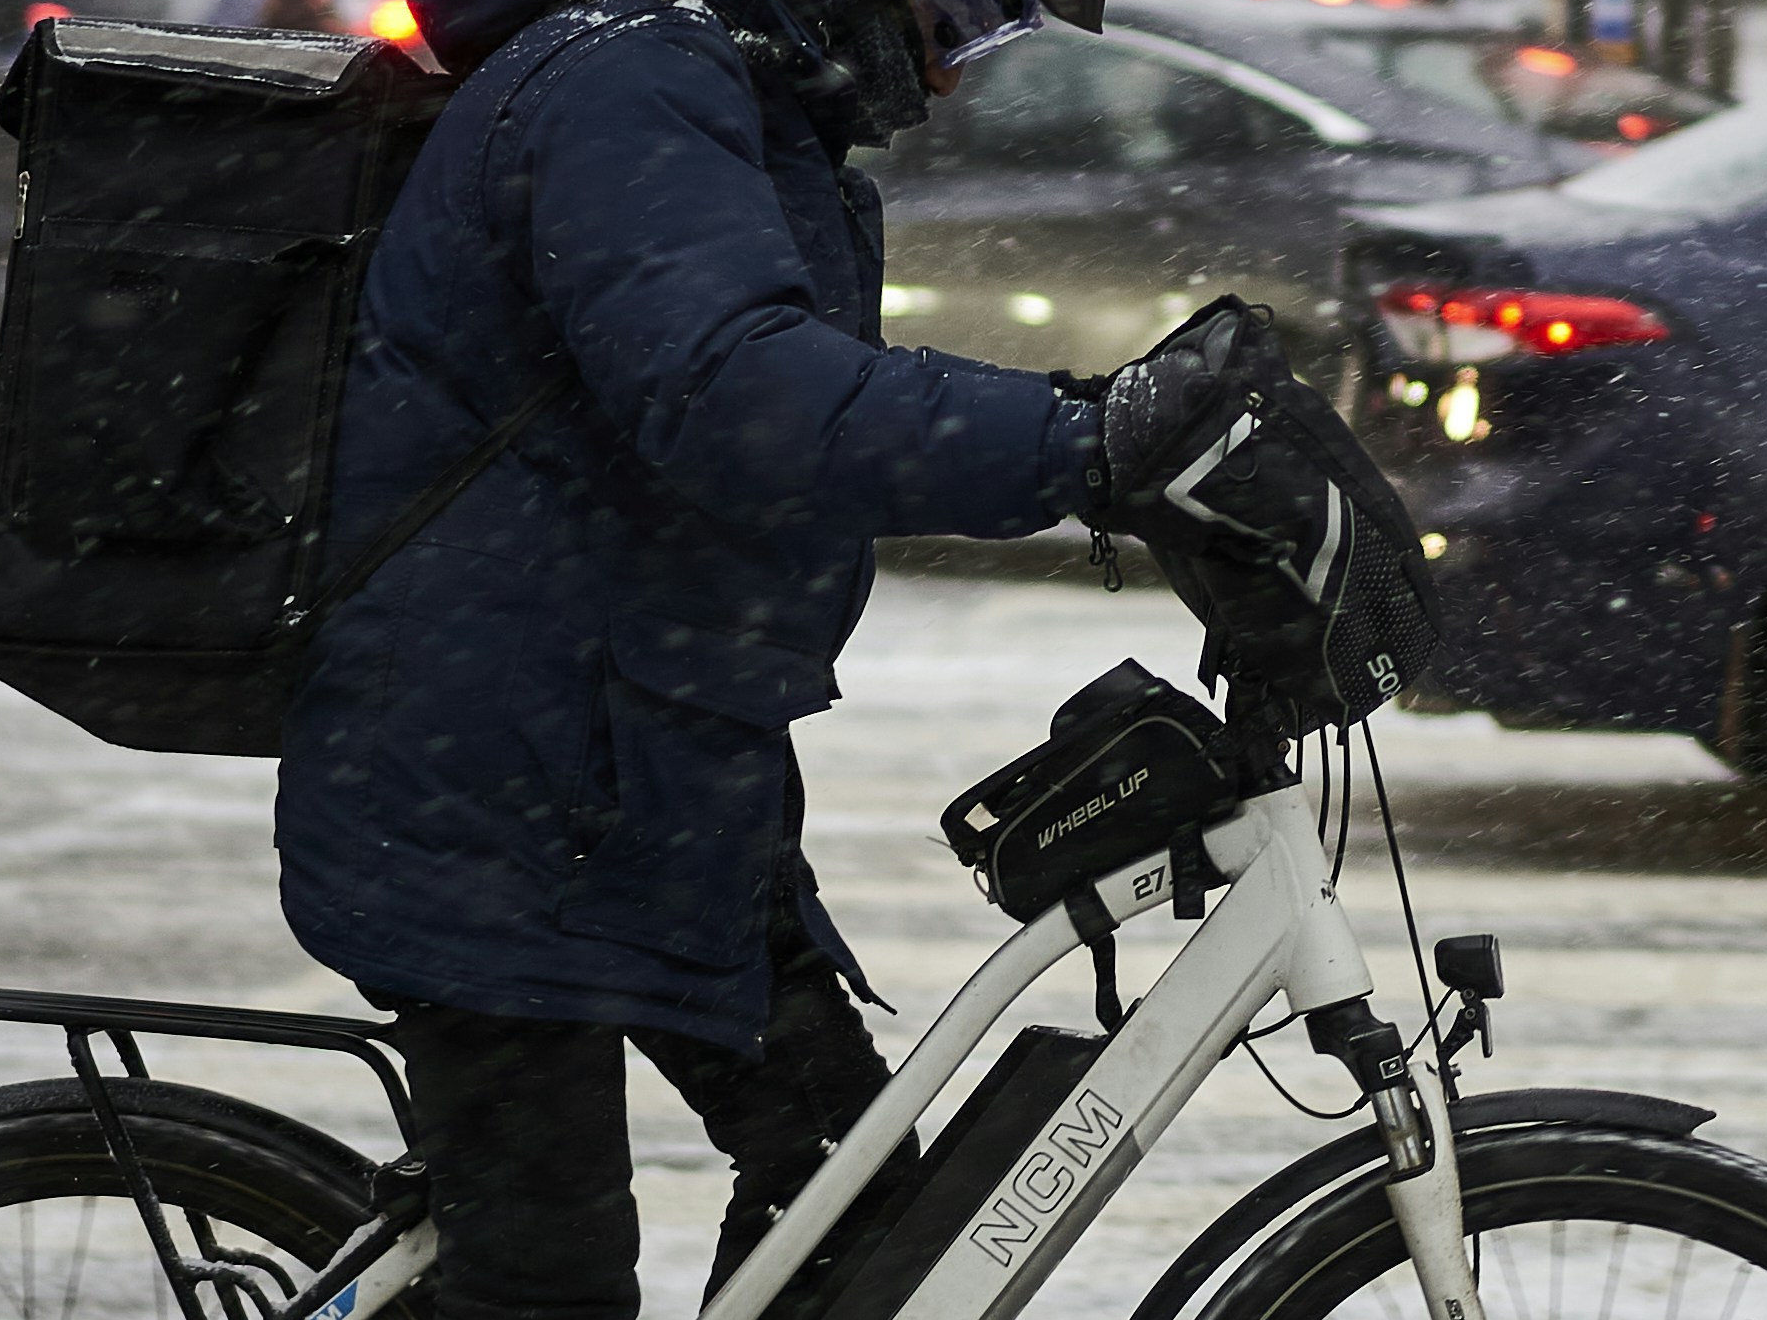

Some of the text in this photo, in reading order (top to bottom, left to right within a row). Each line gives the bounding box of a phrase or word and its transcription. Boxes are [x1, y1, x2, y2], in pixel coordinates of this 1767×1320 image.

[1038, 767, 1150, 850] WHEEL UP
[969, 1088, 1124, 1268] NCM
